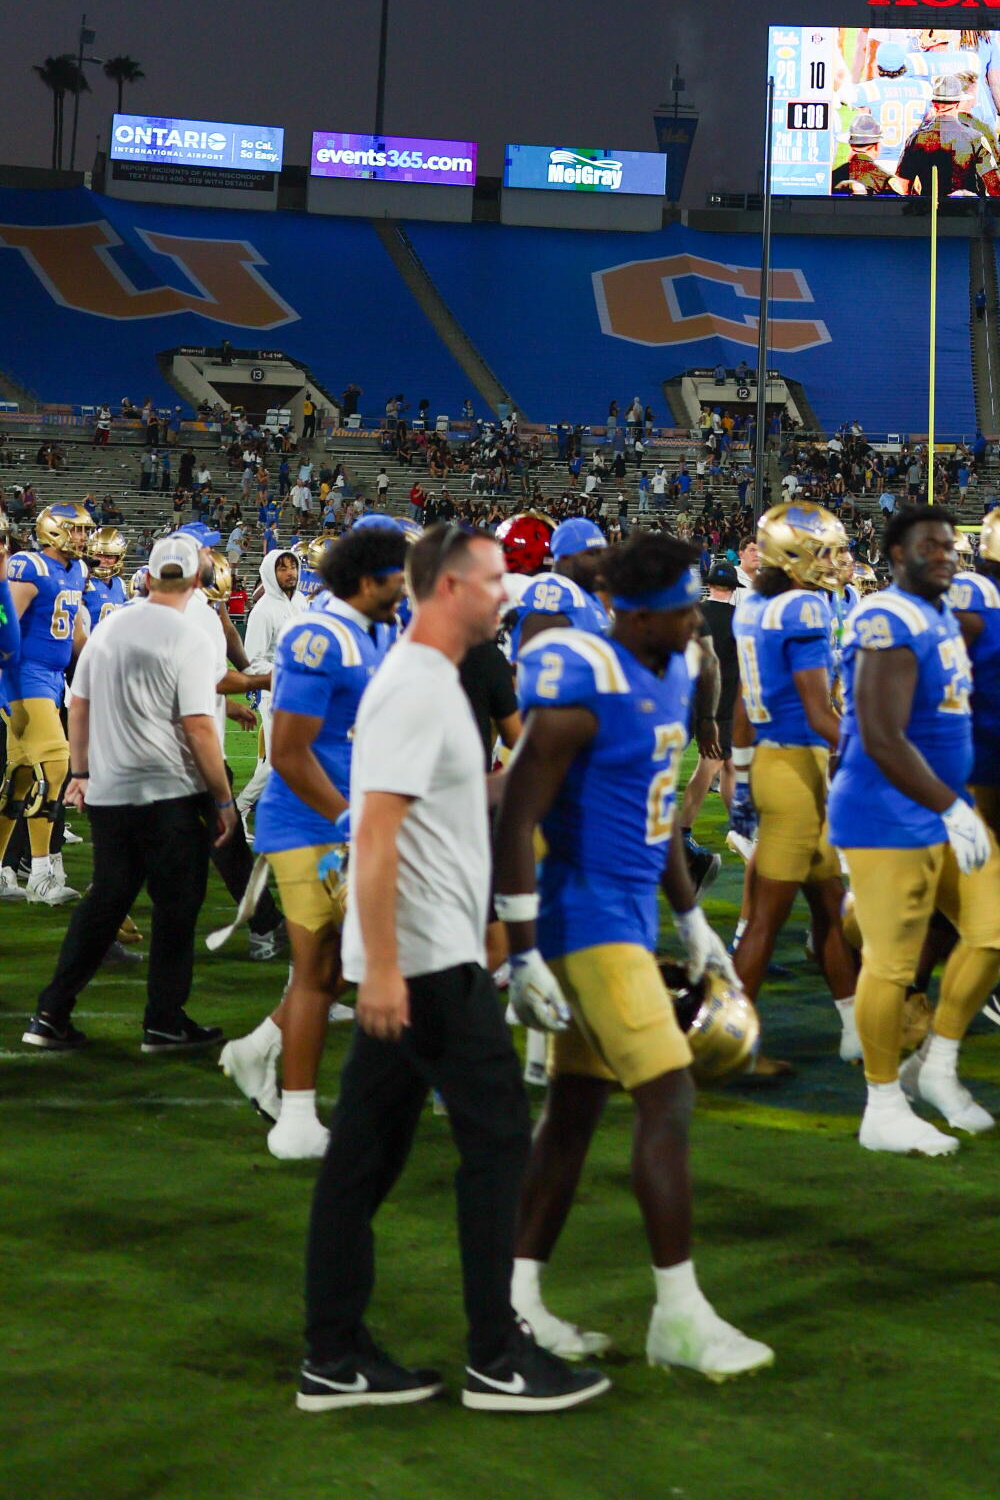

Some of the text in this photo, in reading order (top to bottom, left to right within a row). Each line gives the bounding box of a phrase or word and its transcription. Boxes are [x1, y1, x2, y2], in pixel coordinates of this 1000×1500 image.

[776, 60, 796, 90] 28
[810, 61, 825, 90] 10
[793, 103, 825, 129] 0:08
[114, 146, 224, 161] INTERNATIONAL AIRPORT
[240, 139, 273, 151] So Cal.
[240, 150, 280, 162] So Easy.
[121, 164, 150, 172] REPORT
[151, 166, 189, 175] INCIDENTS
[219, 172, 266, 181] MISCONDUCT
[316, 146, 473, 173] events365.com
[225, 180, 254, 188] DETAILS
[547, 163, 623, 189] MeiGray
[252, 370, 262, 380] 13
[739, 389, 748, 398] 12
[7, 559, 27, 579] 67
[533, 583, 562, 612] 92
[800, 602, 824, 629] 41
[855, 615, 894, 652] 29
[291, 627, 330, 667] 49
[536, 651, 564, 700] 2
[645, 721, 689, 846] 2
